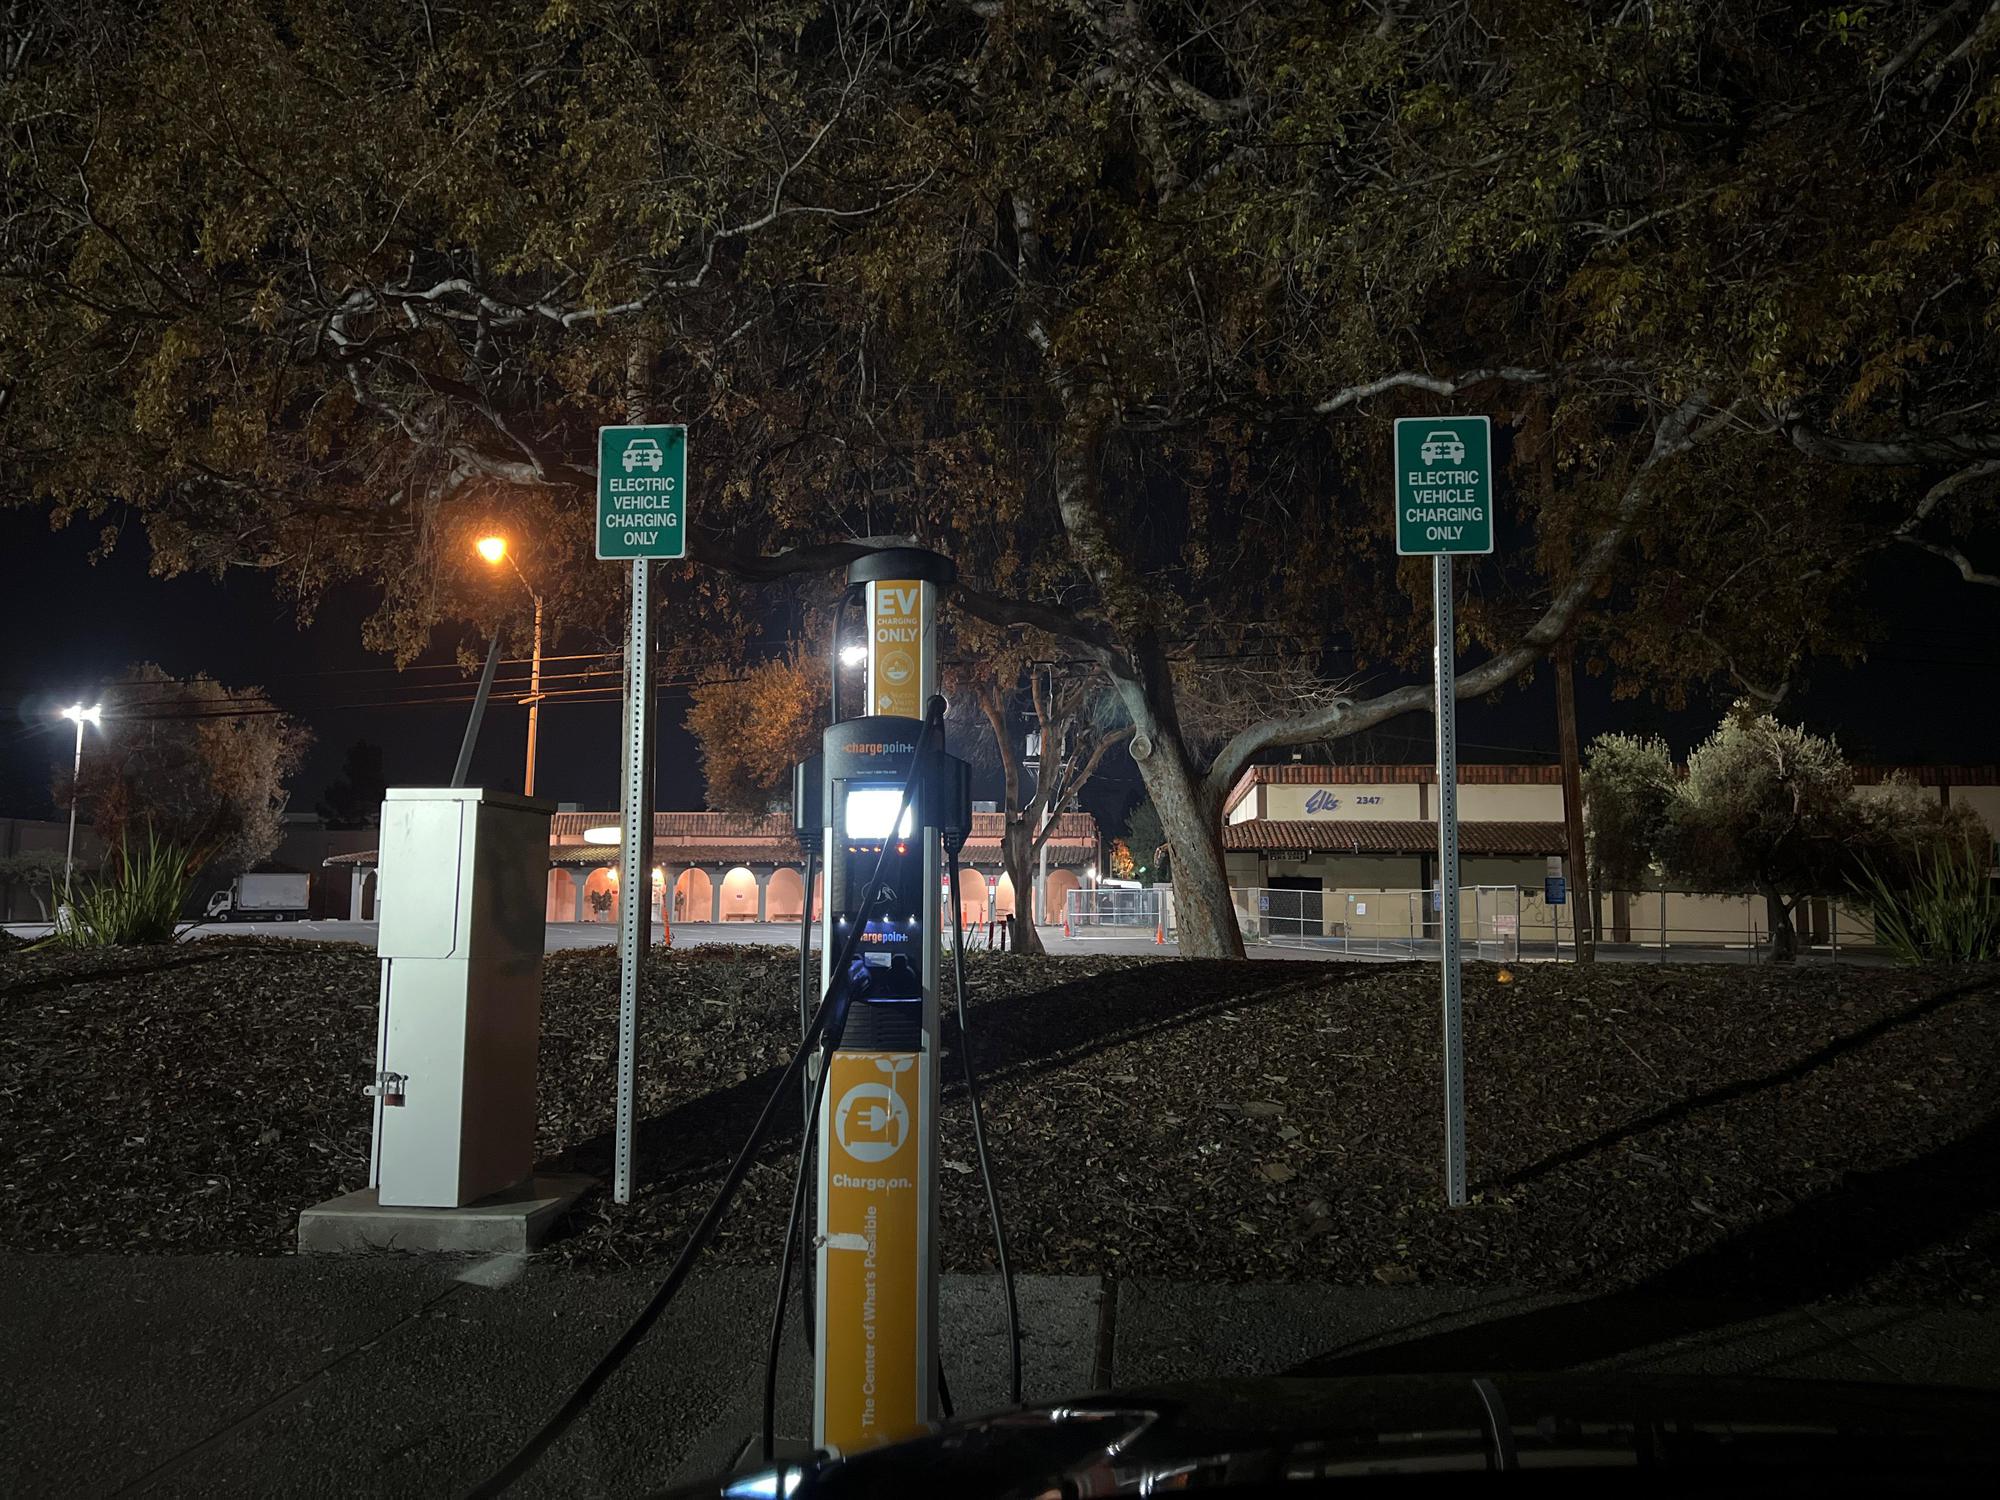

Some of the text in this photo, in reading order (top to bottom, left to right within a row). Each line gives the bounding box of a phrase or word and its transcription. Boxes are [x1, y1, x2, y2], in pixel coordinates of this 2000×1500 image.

[609, 477, 675, 492] ELECTRIC
[1408, 470, 1479, 486] ELECTRIC
[613, 495, 670, 510] VEHICLE
[1413, 489, 1475, 504] VEHICLE
[605, 513, 677, 528] CHARGING
[1406, 507, 1483, 522] CHARGING
[623, 531, 658, 545] ONLY
[1426, 526, 1463, 541] ONLY
[877, 588, 918, 615] EV
[877, 617, 918, 625] CHARGING
[877, 628, 918, 643] ONLY
[1305, 789, 1381, 814] Elks 2347
[832, 1173, 913, 1191] Charge on.
[861, 1205, 877, 1428] The Center of What's Possible
